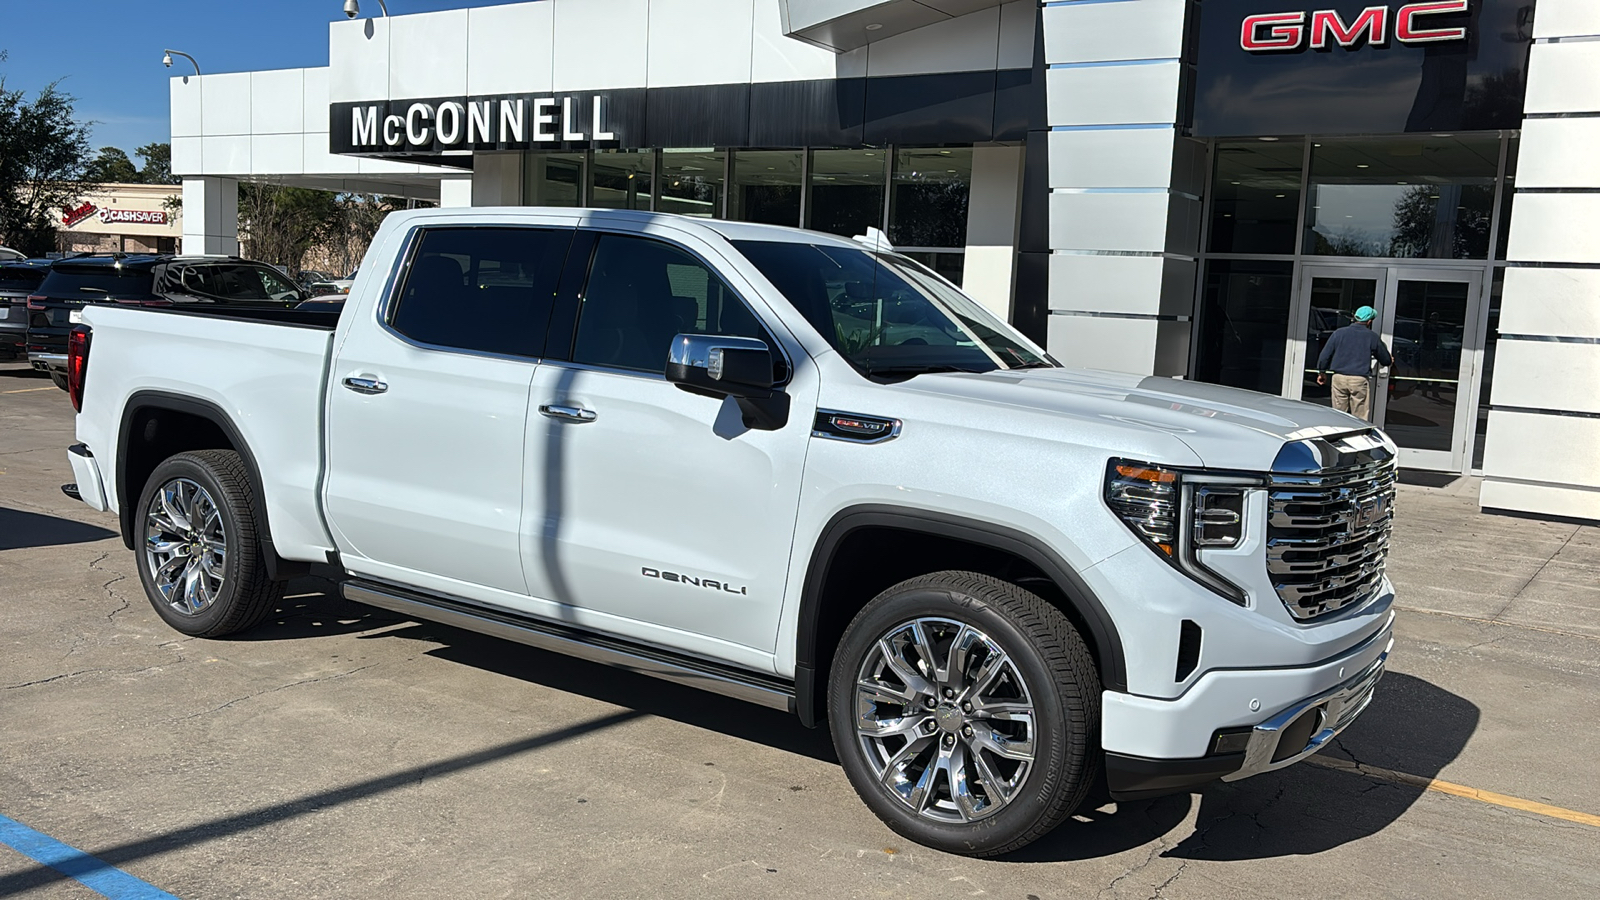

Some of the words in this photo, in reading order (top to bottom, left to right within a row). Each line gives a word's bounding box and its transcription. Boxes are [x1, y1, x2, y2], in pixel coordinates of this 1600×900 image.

[1239, 0, 1469, 51] GMC
[351, 95, 615, 147] McCONNELL
[110, 210, 164, 223] CASHSAVER
[641, 566, 747, 596] DENALI
